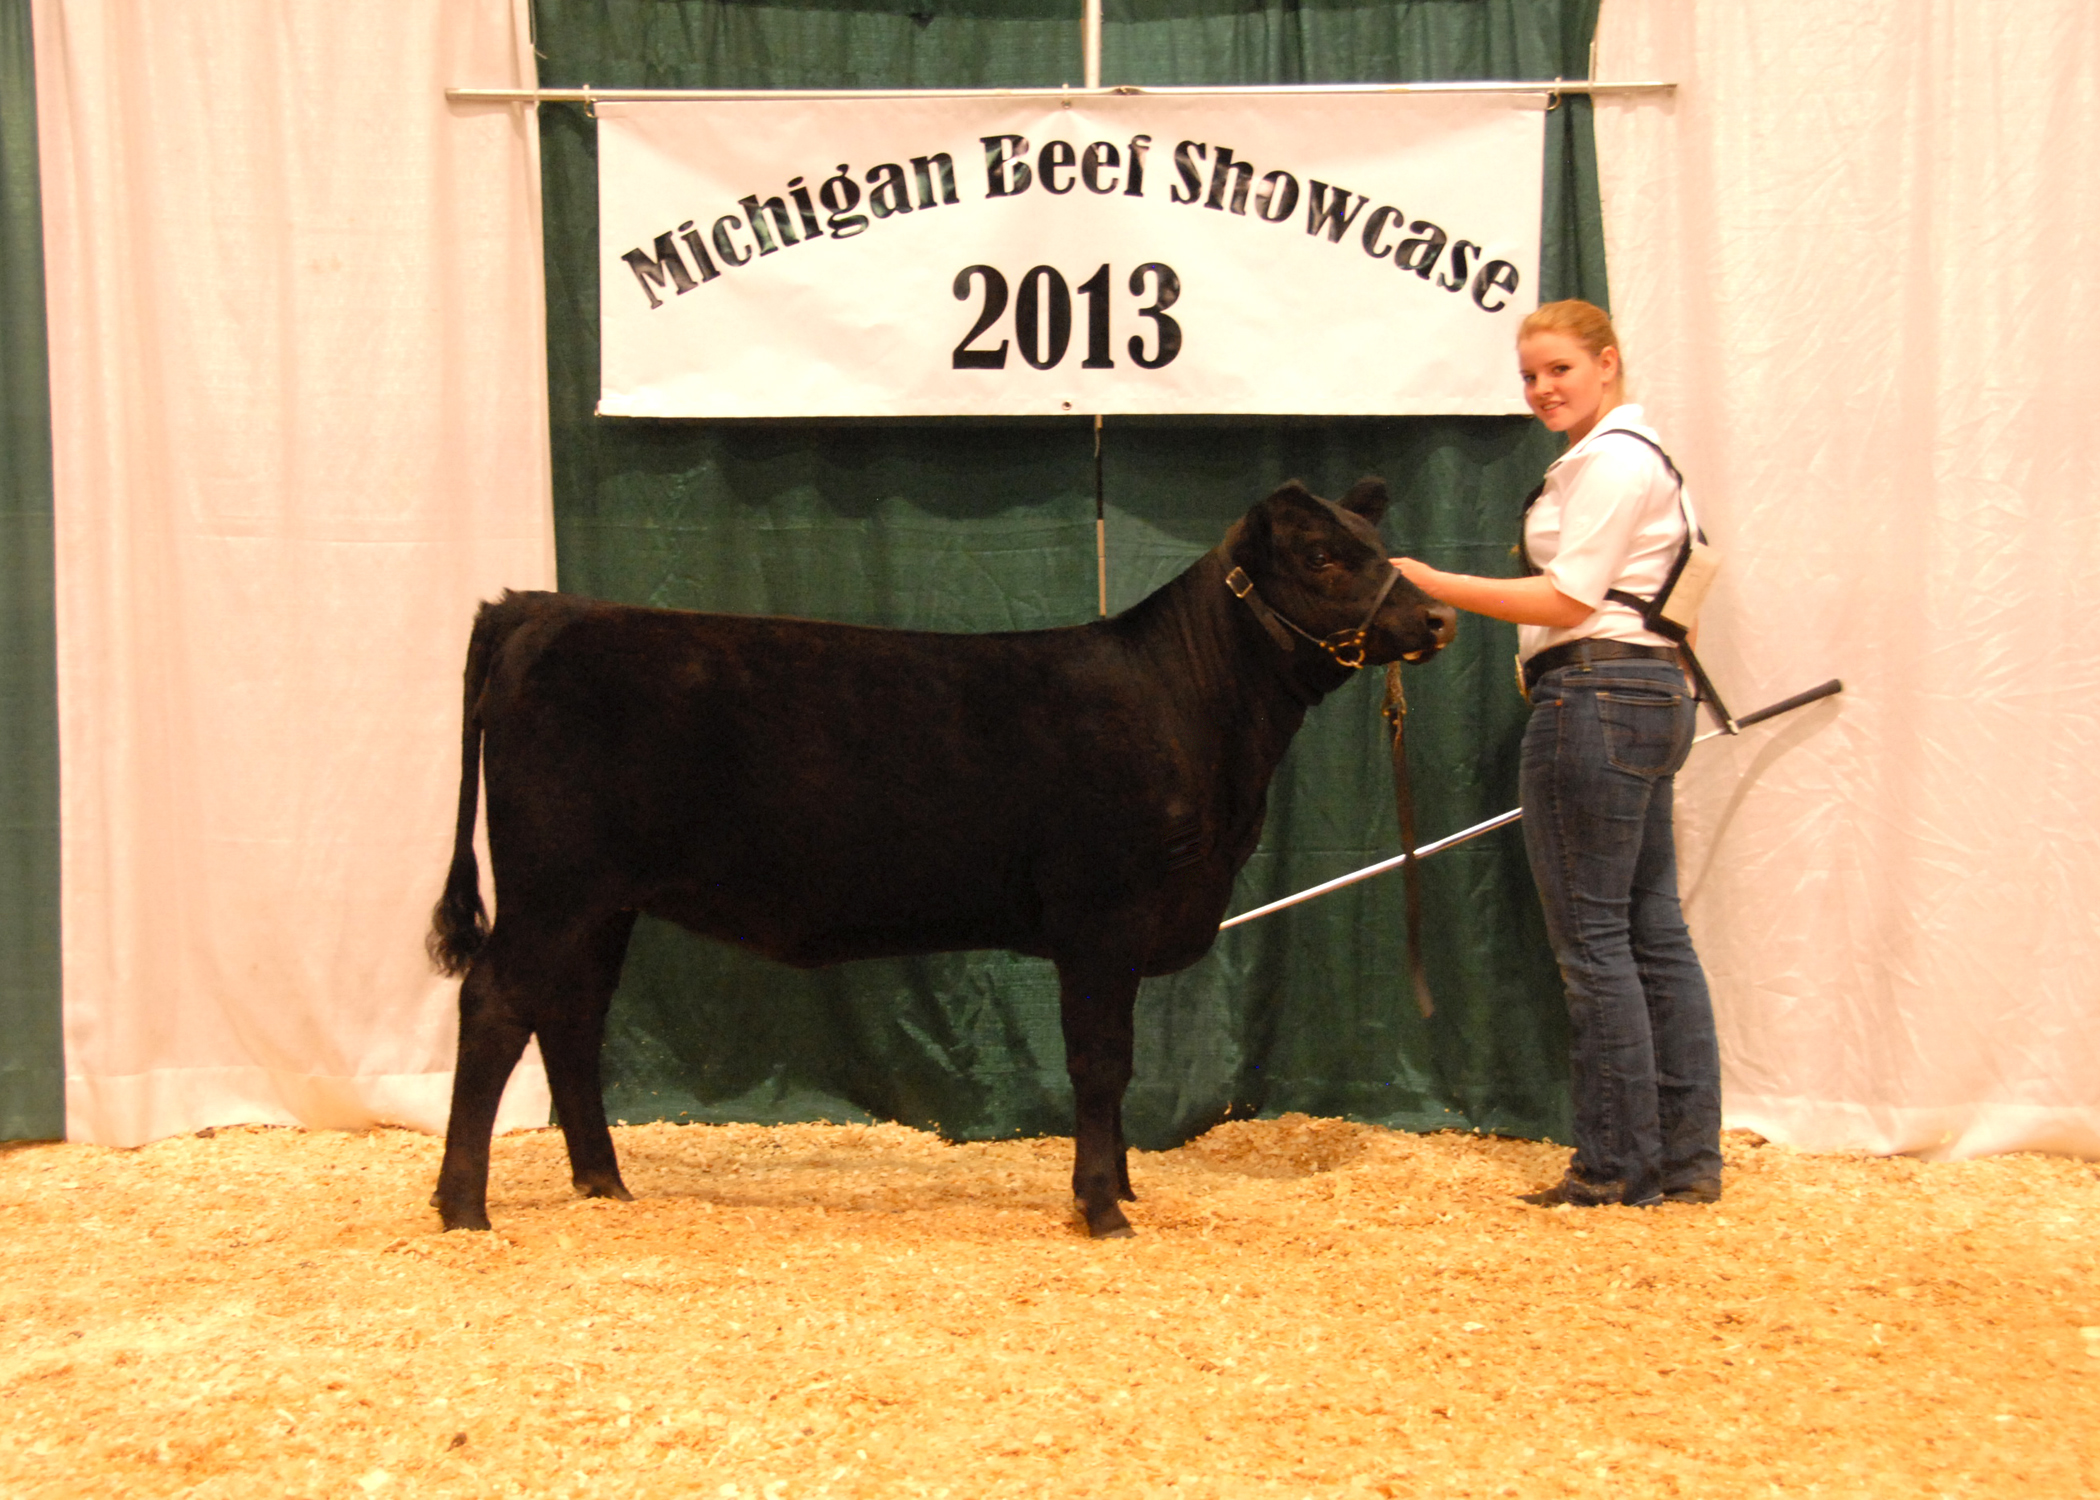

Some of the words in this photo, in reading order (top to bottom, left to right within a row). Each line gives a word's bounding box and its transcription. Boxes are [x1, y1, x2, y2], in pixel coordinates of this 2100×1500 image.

[620, 152, 959, 310] Michigan
[979, 134, 1152, 199] Beef
[1170, 140, 1519, 313] Showcase
[952, 262, 1182, 371] 2013
